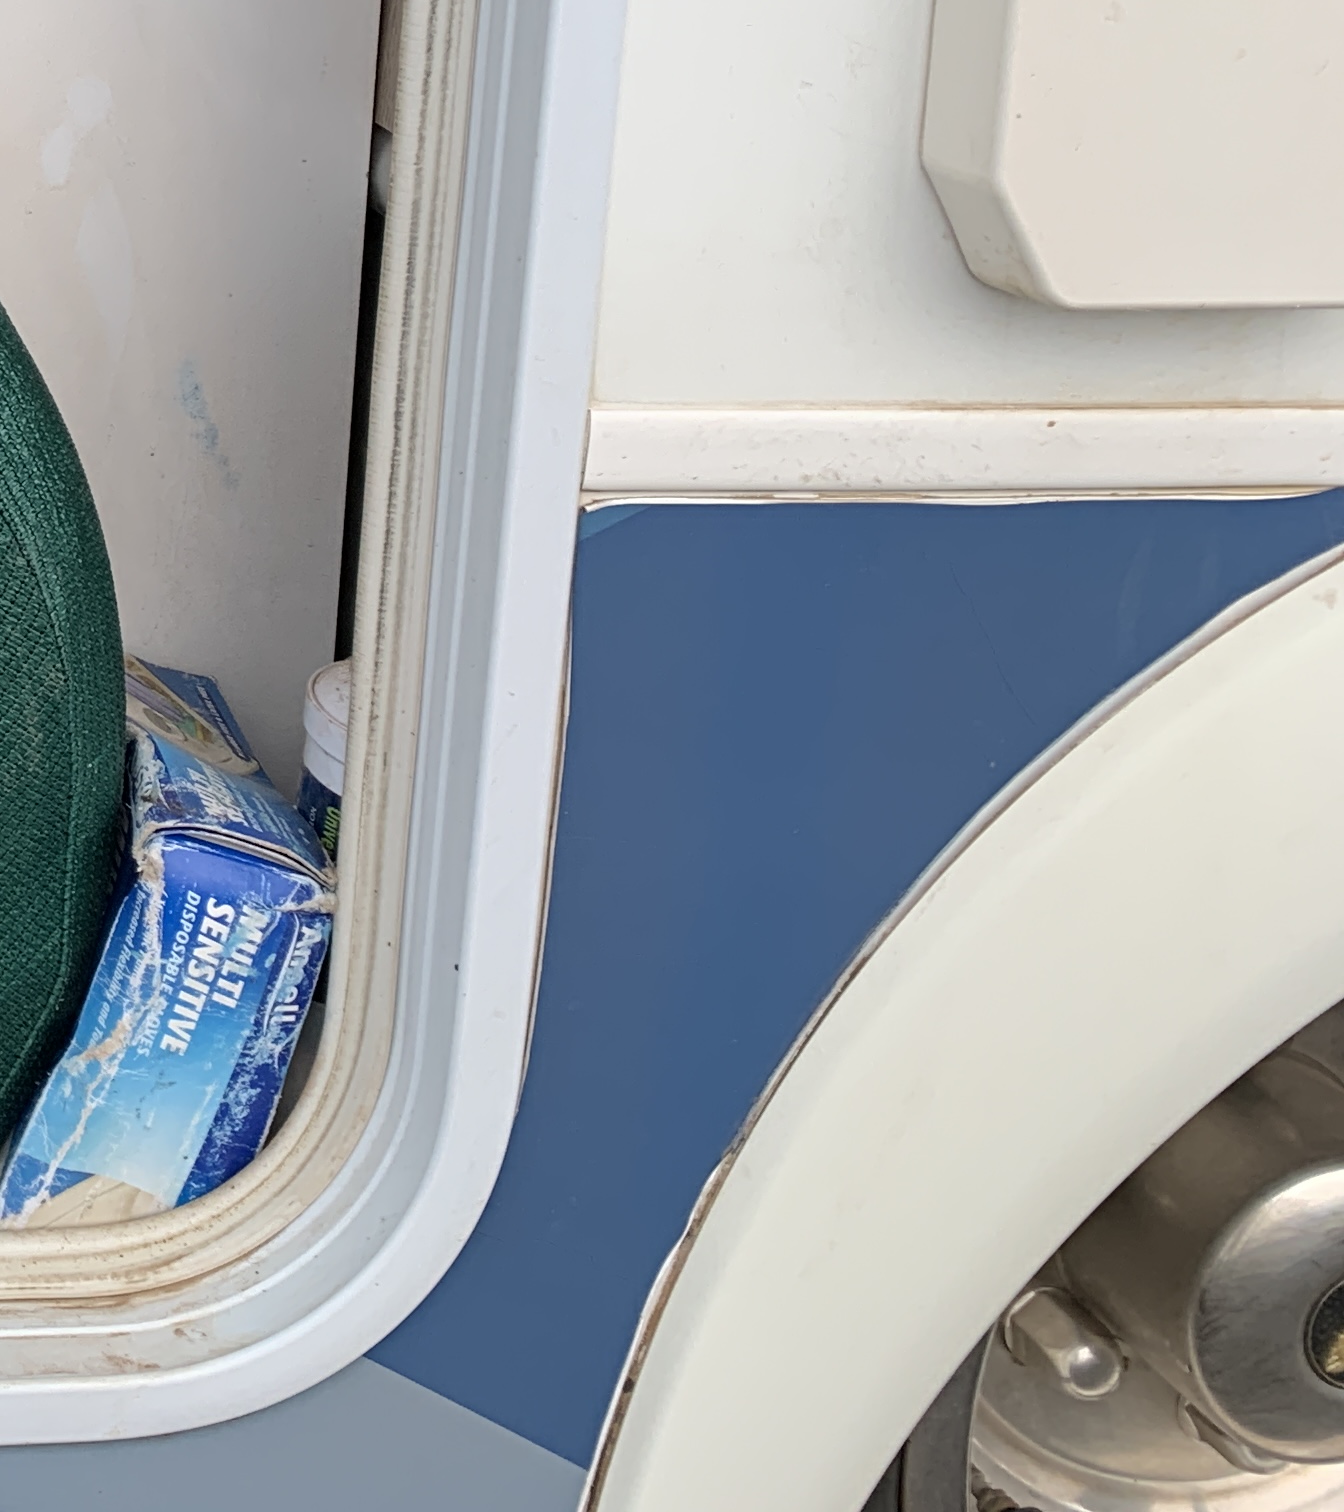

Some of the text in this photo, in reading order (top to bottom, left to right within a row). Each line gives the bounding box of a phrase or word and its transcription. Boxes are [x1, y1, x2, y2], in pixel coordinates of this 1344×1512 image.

[160, 897, 236, 1057] SENSITIVE
[161, 890, 201, 996] DISPOSABLE
[212, 904, 270, 1009] MULTI
